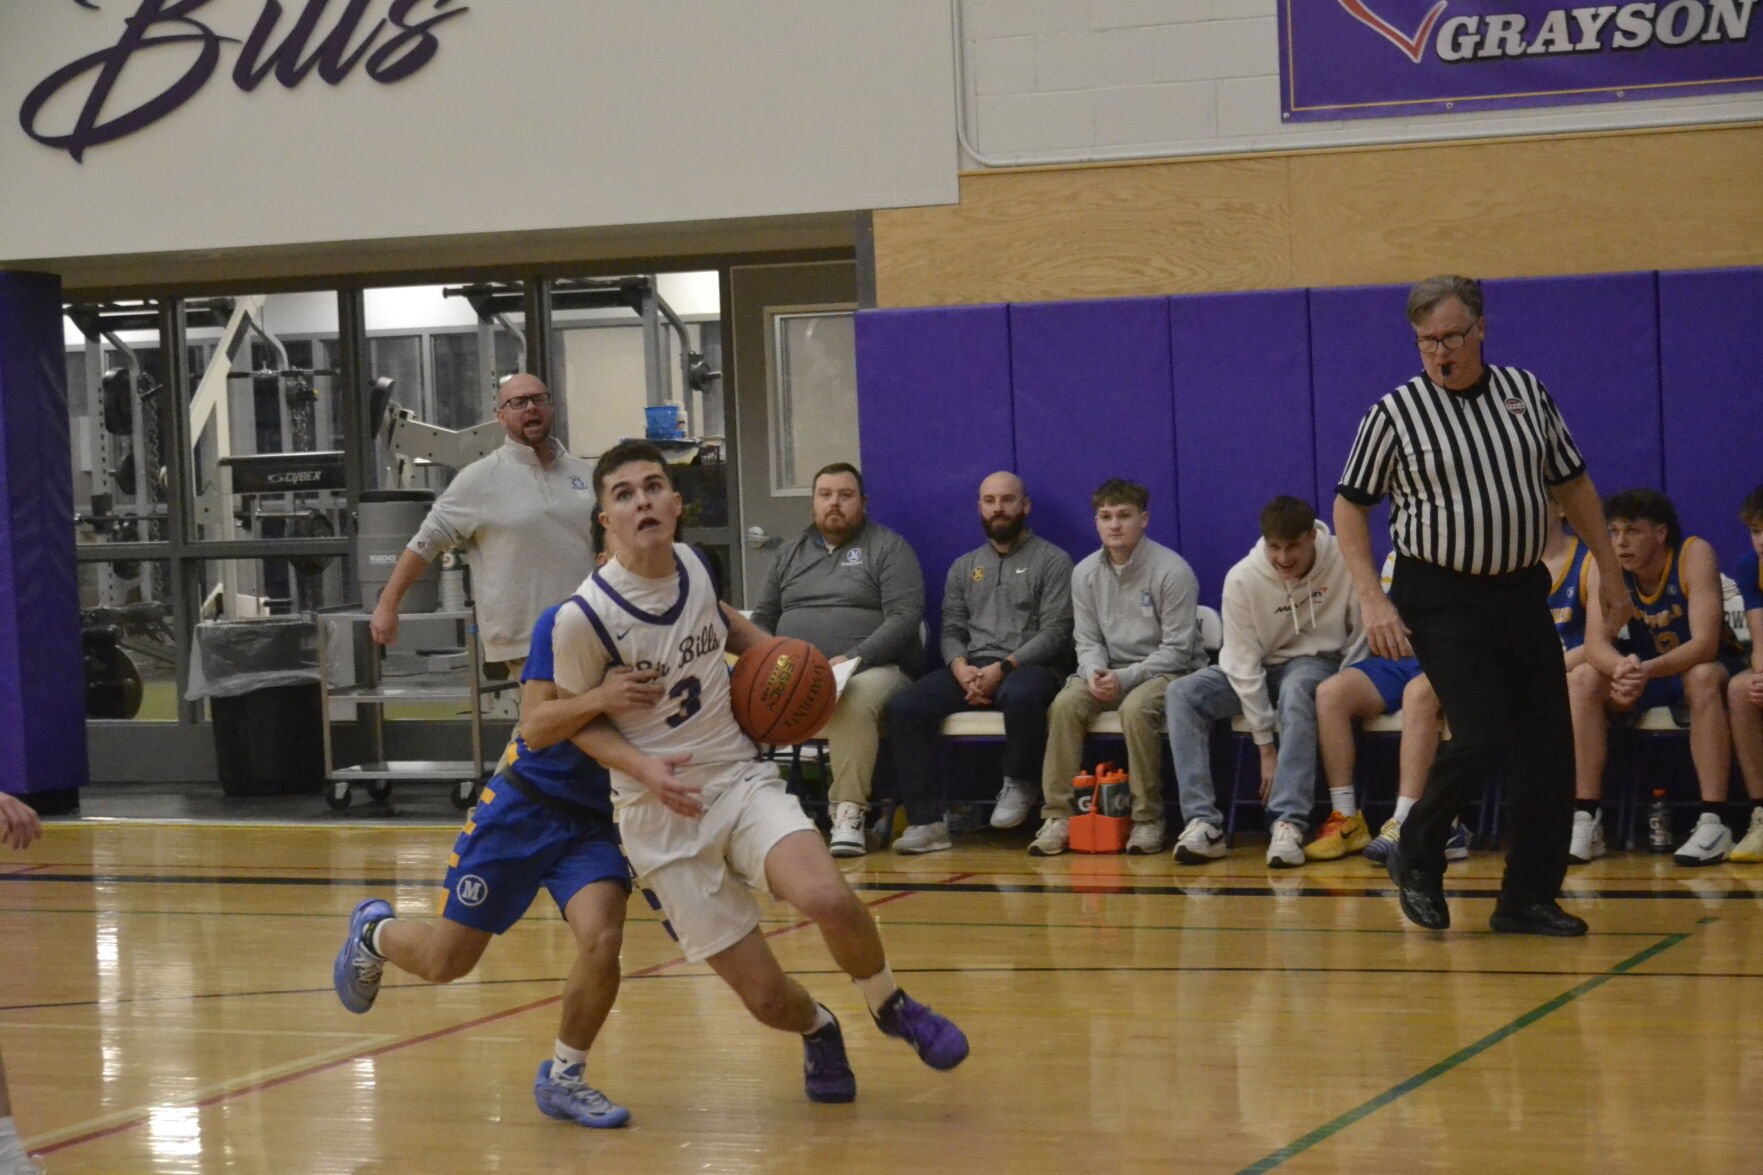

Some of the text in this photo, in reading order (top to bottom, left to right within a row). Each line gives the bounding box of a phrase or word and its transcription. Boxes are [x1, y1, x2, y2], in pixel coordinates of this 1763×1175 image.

[1436, 0, 1761, 62] GRAYSON
[678, 623, 720, 668] Bills
[666, 675, 702, 729] 3
[462, 880, 482, 900] M
